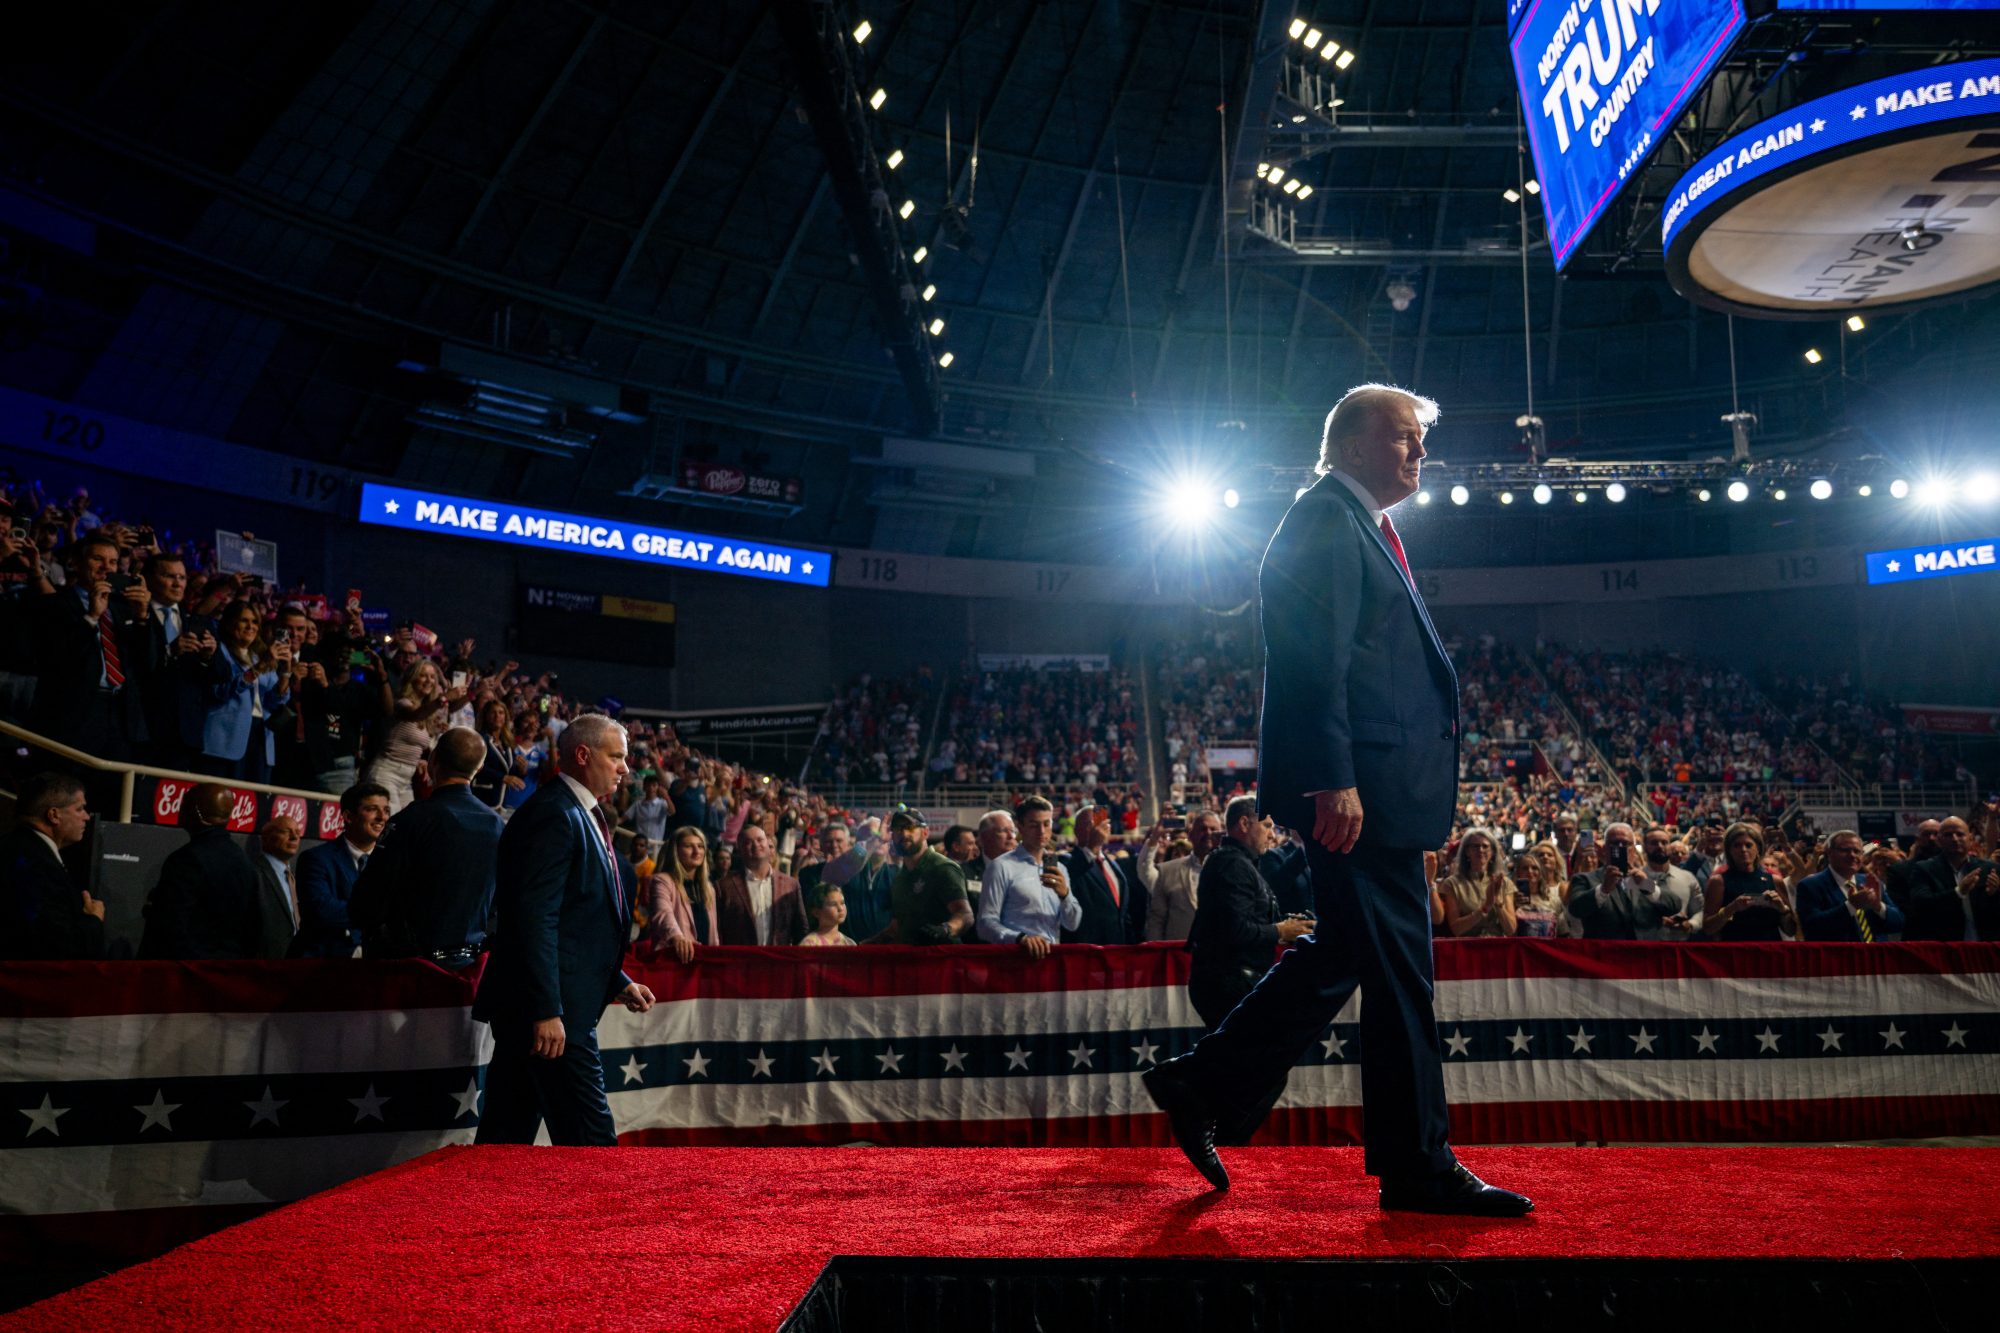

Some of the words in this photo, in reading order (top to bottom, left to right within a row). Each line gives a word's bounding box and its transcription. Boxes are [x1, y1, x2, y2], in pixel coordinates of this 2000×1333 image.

[1537, 1, 1581, 86] NORTH
[1590, 36, 1654, 148] COUNTRY
[1875, 81, 1953, 116] MAKE
[1960, 74, 2000, 100] AM
[1688, 154, 1735, 201] GREAT
[1736, 121, 1804, 170] AGAIN
[1794, 217, 1926, 298] HEALTH
[1832, 217, 1970, 304] NOVANT
[43, 408, 105, 451] 120
[291, 466, 338, 501] 119
[705, 470, 741, 492] Pepper
[415, 499, 499, 532] MAKE
[502, 513, 626, 551] AMERICA
[631, 532, 714, 563] GREAT
[716, 545, 792, 575] AGAIN
[861, 557, 897, 582] 118
[1777, 556, 1819, 581] 113
[1914, 543, 1996, 573] MAKE
[1035, 569, 1071, 593] 117
[1600, 568, 1639, 592] 114
[709, 715, 816, 731] HendrickAcura.com
[158, 783, 190, 816] Ed'
[231, 792, 255, 820] d's
